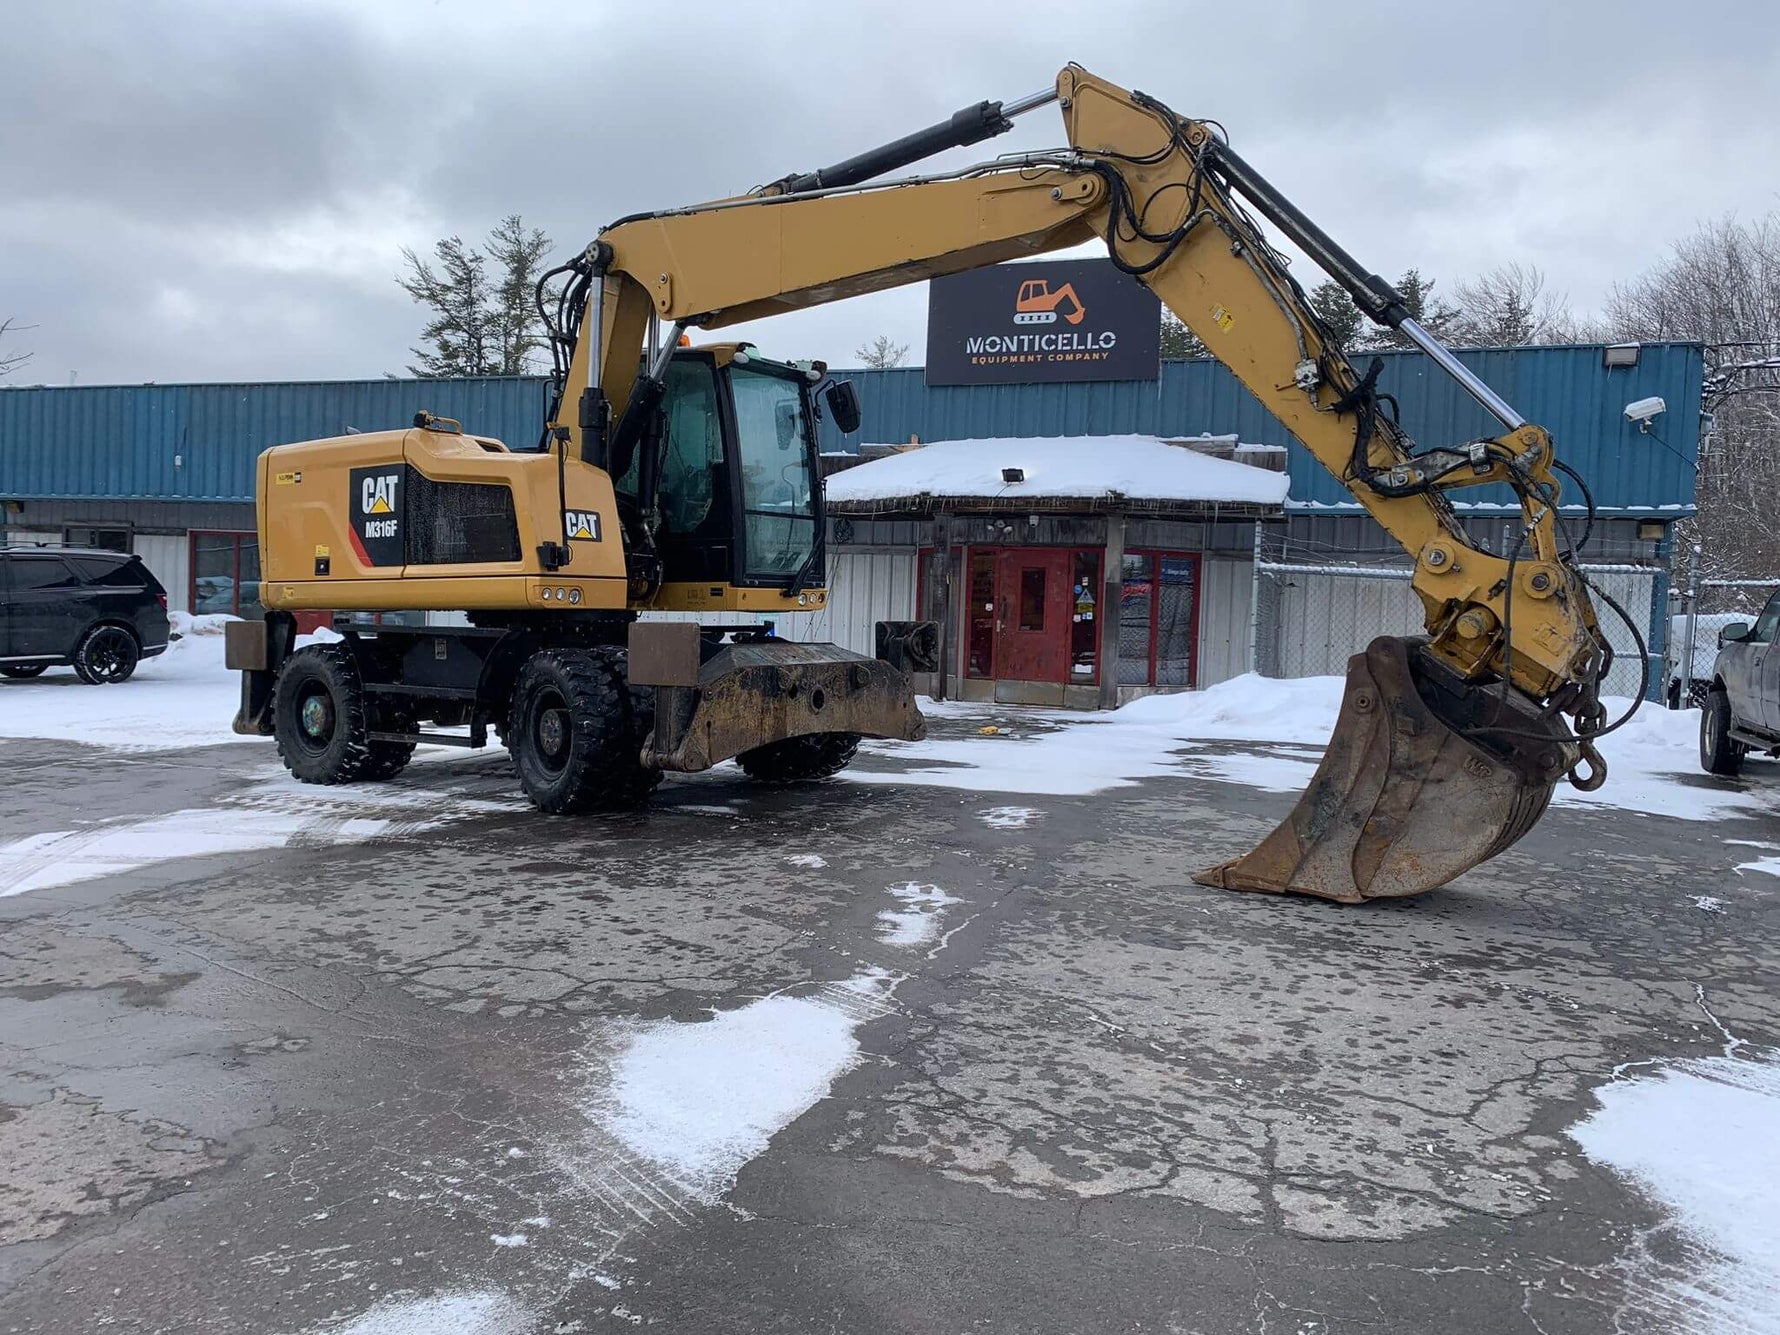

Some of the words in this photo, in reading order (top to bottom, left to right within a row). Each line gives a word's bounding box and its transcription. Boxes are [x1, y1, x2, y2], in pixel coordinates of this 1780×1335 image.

[966, 331, 1117, 354] MONTICELLO
[971, 354, 1043, 365] EQUIPMENT
[1048, 352, 1110, 362] COMPANY
[362, 475, 398, 514] CAT
[365, 519, 398, 538] M316F
[565, 511, 597, 539] CAT
